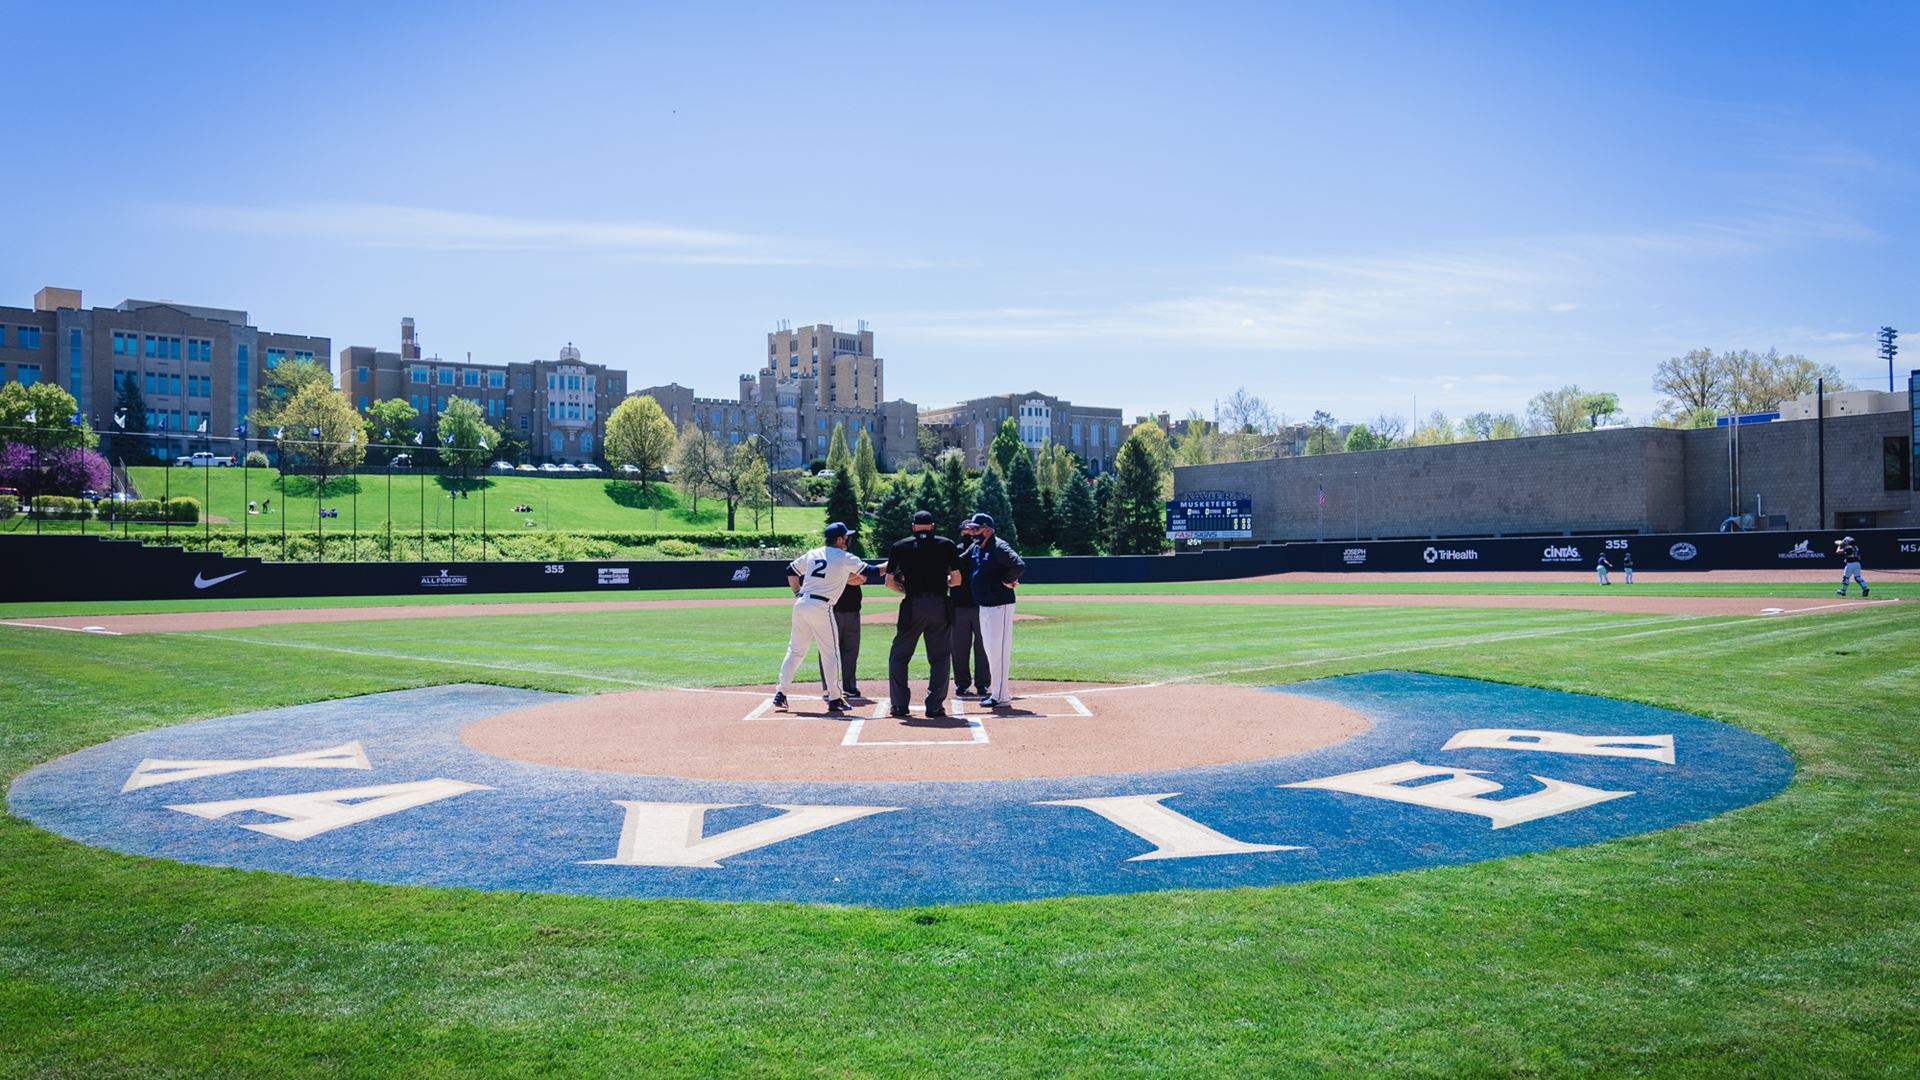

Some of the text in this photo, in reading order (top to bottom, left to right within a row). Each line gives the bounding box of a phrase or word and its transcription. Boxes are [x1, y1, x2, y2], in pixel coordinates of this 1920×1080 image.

[1605, 540, 1628, 549] 355
[1439, 550, 1478, 559] TriHealth
[440, 569, 448, 577] X
[544, 565, 565, 573] 355
[811, 559, 828, 578] 2
[121, 727, 1676, 869] XAVIER
